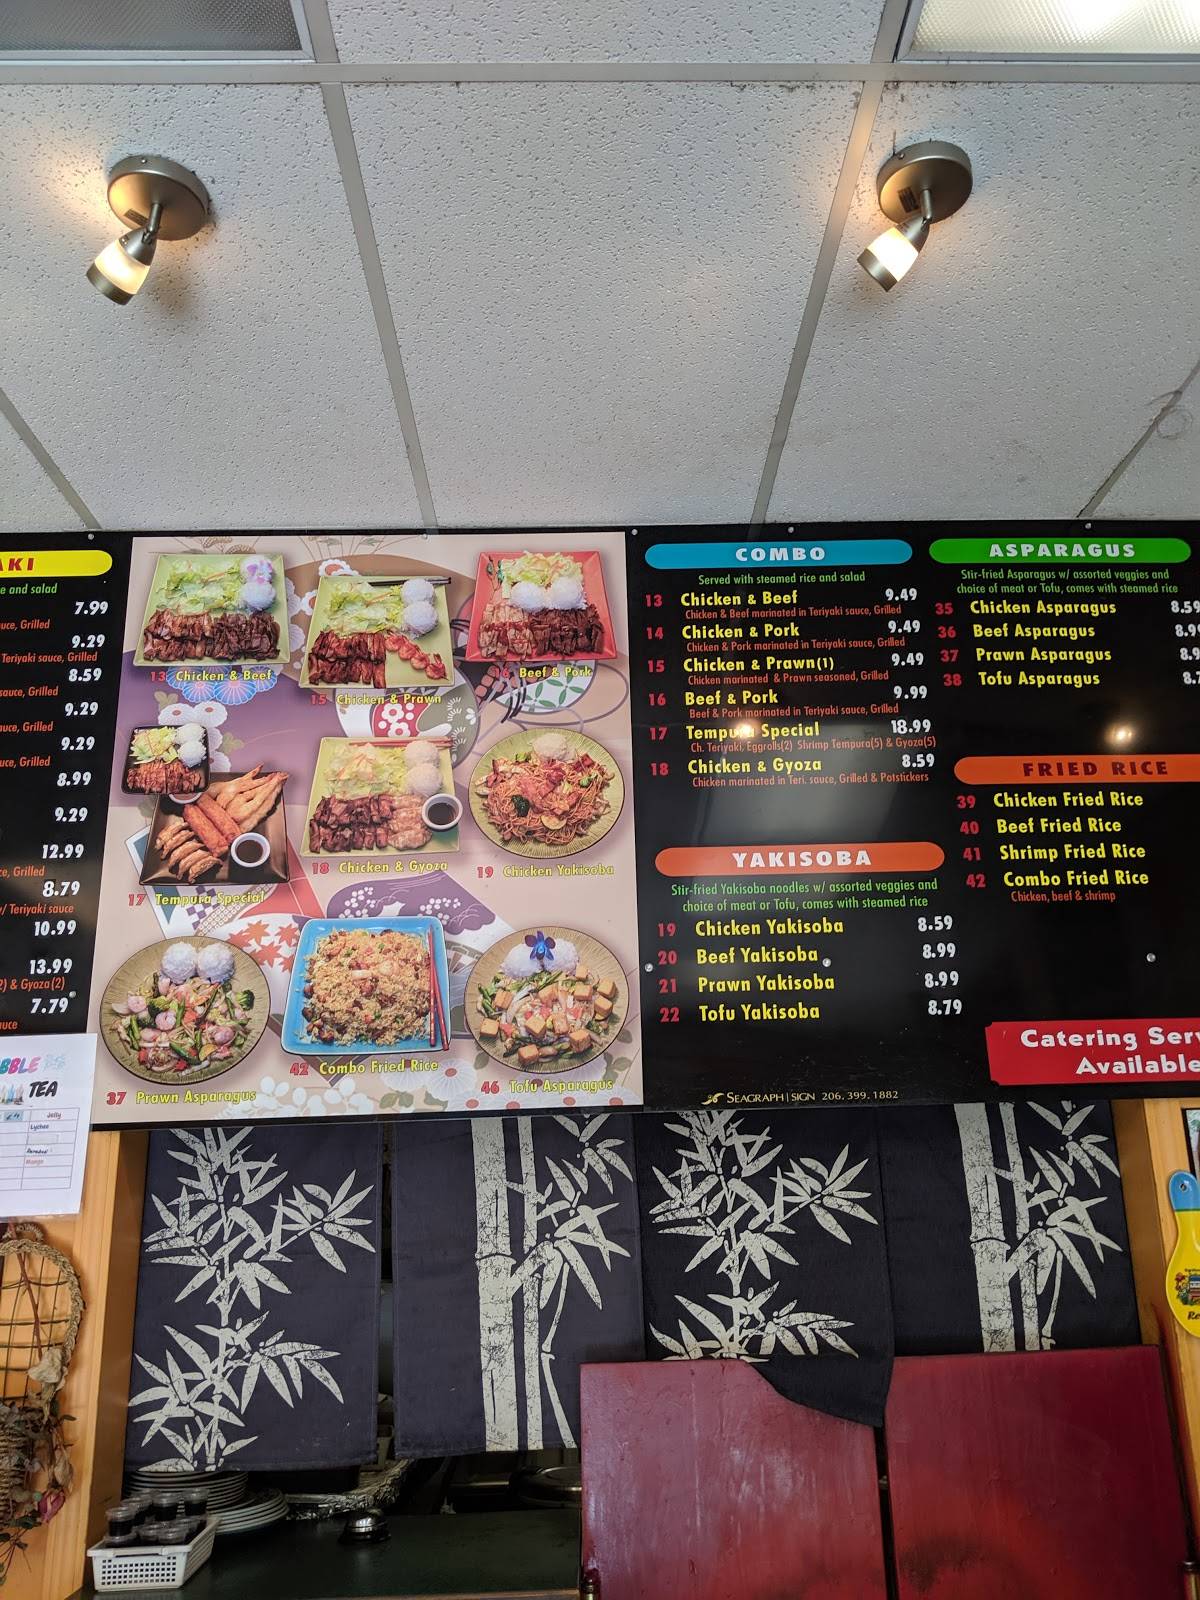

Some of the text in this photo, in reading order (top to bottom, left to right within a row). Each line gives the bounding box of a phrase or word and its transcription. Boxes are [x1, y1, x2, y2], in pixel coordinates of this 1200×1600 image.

[735, 547, 826, 562] COMBO
[989, 543, 1136, 558] ASPARAGUS
[698, 571, 866, 585] Served with steamed rice and salad
[960, 568, 1170, 582] Stir-fried Asparagus w/ assorted veggies and
[645, 588, 918, 607] 13 Chicken & Beef 9.49
[74, 600, 109, 615] 7.99
[685, 604, 902, 620] Chicken & Beef marinated in Teriyaki sauce, Grilled
[935, 600, 1200, 617] 35 Chicken Asparagus 8.59
[646, 620, 921, 640] 14 Chicken & Pork 9.49
[938, 623, 1096, 640] 36 Beef Asparagus
[71, 634, 106, 648] 9.29
[1, 651, 98, 664] Teriyaki sauce, Grilled
[648, 652, 924, 673] 15 Chicken & Prawn(1) 9.49
[940, 647, 1112, 664] 37 Prawn Asparagus
[68, 667, 102, 682] 8.59
[175, 670, 225, 681] Chicken
[229, 670, 238, 681] &
[243, 669, 272, 681] Beef
[943, 670, 1100, 688] 38 Tofu Asparagus
[649, 685, 928, 706] 16 Beef & Pork 9.99
[64, 701, 99, 716] 9.29
[649, 719, 932, 741] 17 Special 18.99
[61, 736, 96, 751] 9.29
[651, 753, 935, 776] 18 Chicken & Gyoza 8.59
[1022, 761, 1168, 777] FRIED RICE
[56, 771, 92, 787] 8.99
[957, 791, 1144, 809] 39 Chicken Fried Rice
[54, 807, 88, 822] 9.29
[960, 817, 1122, 834] 40 Beef Fried Rice
[42, 844, 85, 859] 12.99
[732, 850, 873, 868] YAKISOBA
[963, 842, 1146, 862] 41 Shrimp Fried Rice
[311, 859, 449, 875] 18 Chicken & Gyoza
[476, 862, 615, 879] 19 Chicken Yakisoba
[966, 869, 1150, 888] 42 Combo Fried Rice
[42, 880, 81, 898] 8.79
[1010, 889, 1116, 903] Chicken, beef & shrimp
[127, 890, 266, 907] 17 Tempura Special
[34, 920, 77, 936] 10.99
[658, 915, 953, 937] 19 Chicken Yakisoba 8.59
[658, 942, 956, 965] 20 Beef Yakisoba 8.99
[29, 958, 73, 975] 13.99
[658, 971, 959, 993] 21 Prawn Yakisoba 8.99
[30, 997, 69, 1014] 7.79
[659, 999, 963, 1022] 22 Tofu Yakisoba 8.79
[1020, 1029, 1138, 1050] Catering
[289, 1058, 439, 1076] 42 Combo Fried Rice
[1075, 1054, 1200, 1074] Available
[28, 1080, 58, 1098] TEA
[480, 1079, 614, 1095] 46 Tofu Asparagus
[106, 1089, 257, 1106] 37 Prawn Asparagus
